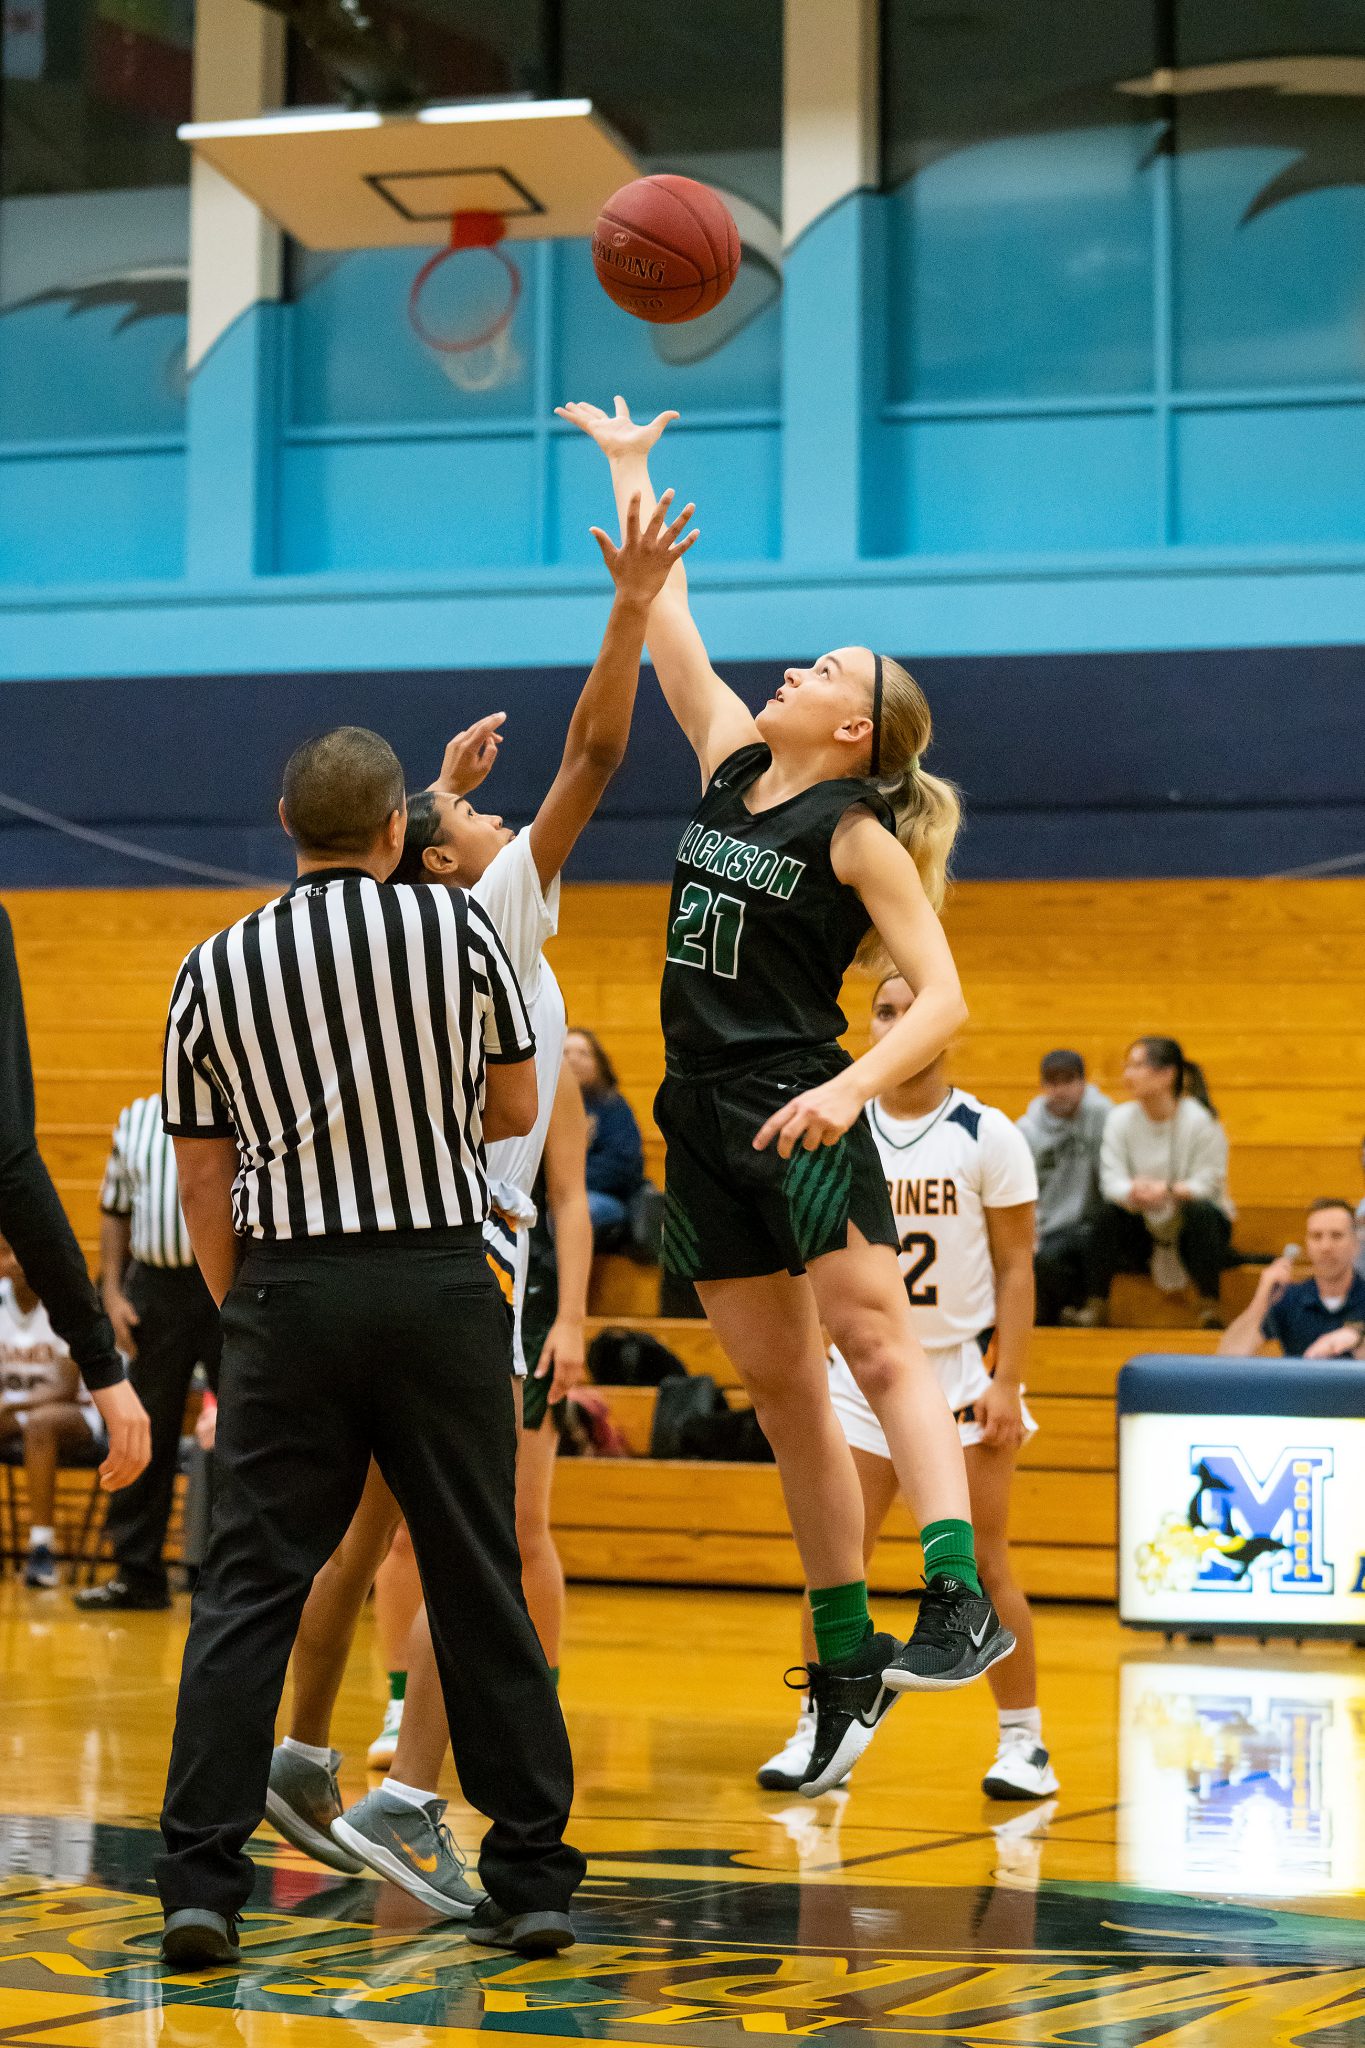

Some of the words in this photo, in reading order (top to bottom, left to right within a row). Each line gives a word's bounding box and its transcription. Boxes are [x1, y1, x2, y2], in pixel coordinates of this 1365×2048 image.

[676, 820, 807, 900] ACKSON
[666, 881, 746, 980] 21
[901, 1231, 938, 1306] 2
